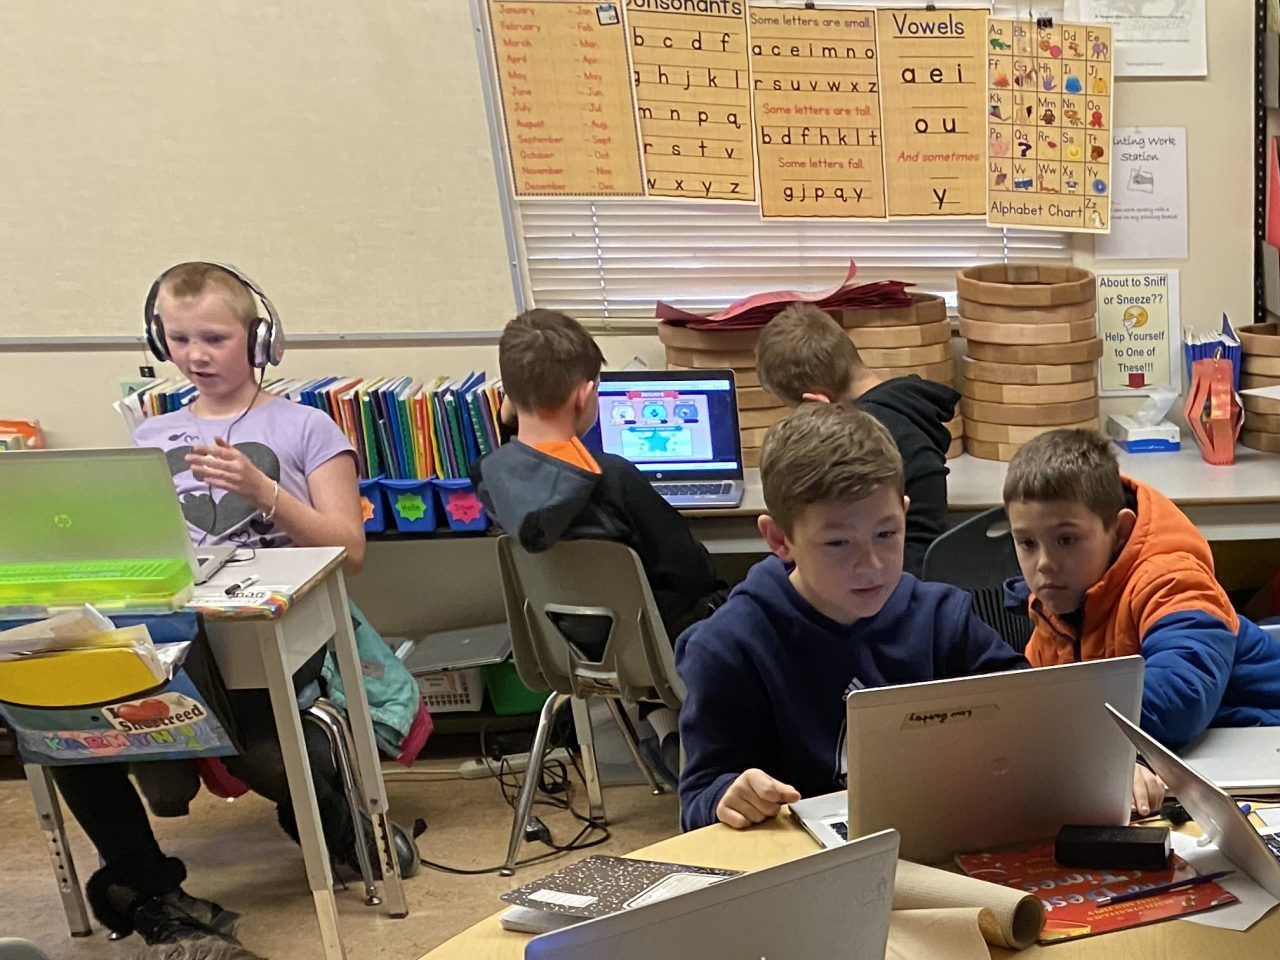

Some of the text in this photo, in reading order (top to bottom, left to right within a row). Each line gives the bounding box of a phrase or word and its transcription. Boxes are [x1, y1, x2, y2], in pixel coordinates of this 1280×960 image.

[626, 0, 742, 15] onsonants
[750, 13, 871, 29] Some letters are small.
[892, 13, 965, 35] Vowels
[633, 27, 730, 51] b c d f
[989, 24, 1100, 43] Aa Bb Cc Dd Ee
[752, 43, 874, 59] a c e i m n o
[507, 54, 527, 66] April
[659, 65, 669, 84] h
[684, 71, 690, 90] j
[708, 68, 718, 87] k
[736, 70, 739, 88] l
[901, 64, 962, 83] a e i
[755, 79, 878, 93] r s u v w x z
[763, 104, 872, 117] Some letters are tall.
[989, 94, 1100, 112] Kk Ll Mm Nn Oo
[671, 110, 680, 120] n
[699, 111, 708, 126] p
[727, 113, 740, 129] q
[915, 118, 957, 134] o u
[518, 134, 563, 145] September
[761, 127, 878, 146] b d f h k l t
[989, 128, 1097, 144] Pp Qq Rr Ss Tt
[1113, 136, 1176, 148] inting Work
[520, 150, 554, 160] October
[644, 141, 734, 158] r s t v
[898, 151, 979, 162] And sometimes
[1121, 152, 1159, 161] Station
[522, 167, 563, 175] November
[778, 158, 864, 169] Some letters fall.
[989, 162, 1098, 180] Uu Vv Ww Xx Yy
[525, 182, 566, 190] December
[675, 180, 684, 190] x
[702, 181, 711, 196] y
[730, 183, 739, 193] z
[783, 184, 863, 202] g j p q y
[933, 187, 947, 210] y
[1086, 199, 1097, 210] Zz
[991, 202, 1083, 219] Alphabet Chart
[1100, 276, 1166, 287] About to Sniff
[1117, 294, 1163, 304] Sneeze??
[1105, 331, 1164, 343] Help Yourself
[1115, 347, 1155, 356] to One of
[1118, 363, 1153, 372] These!!!
[1022, 869, 1128, 893] Times
